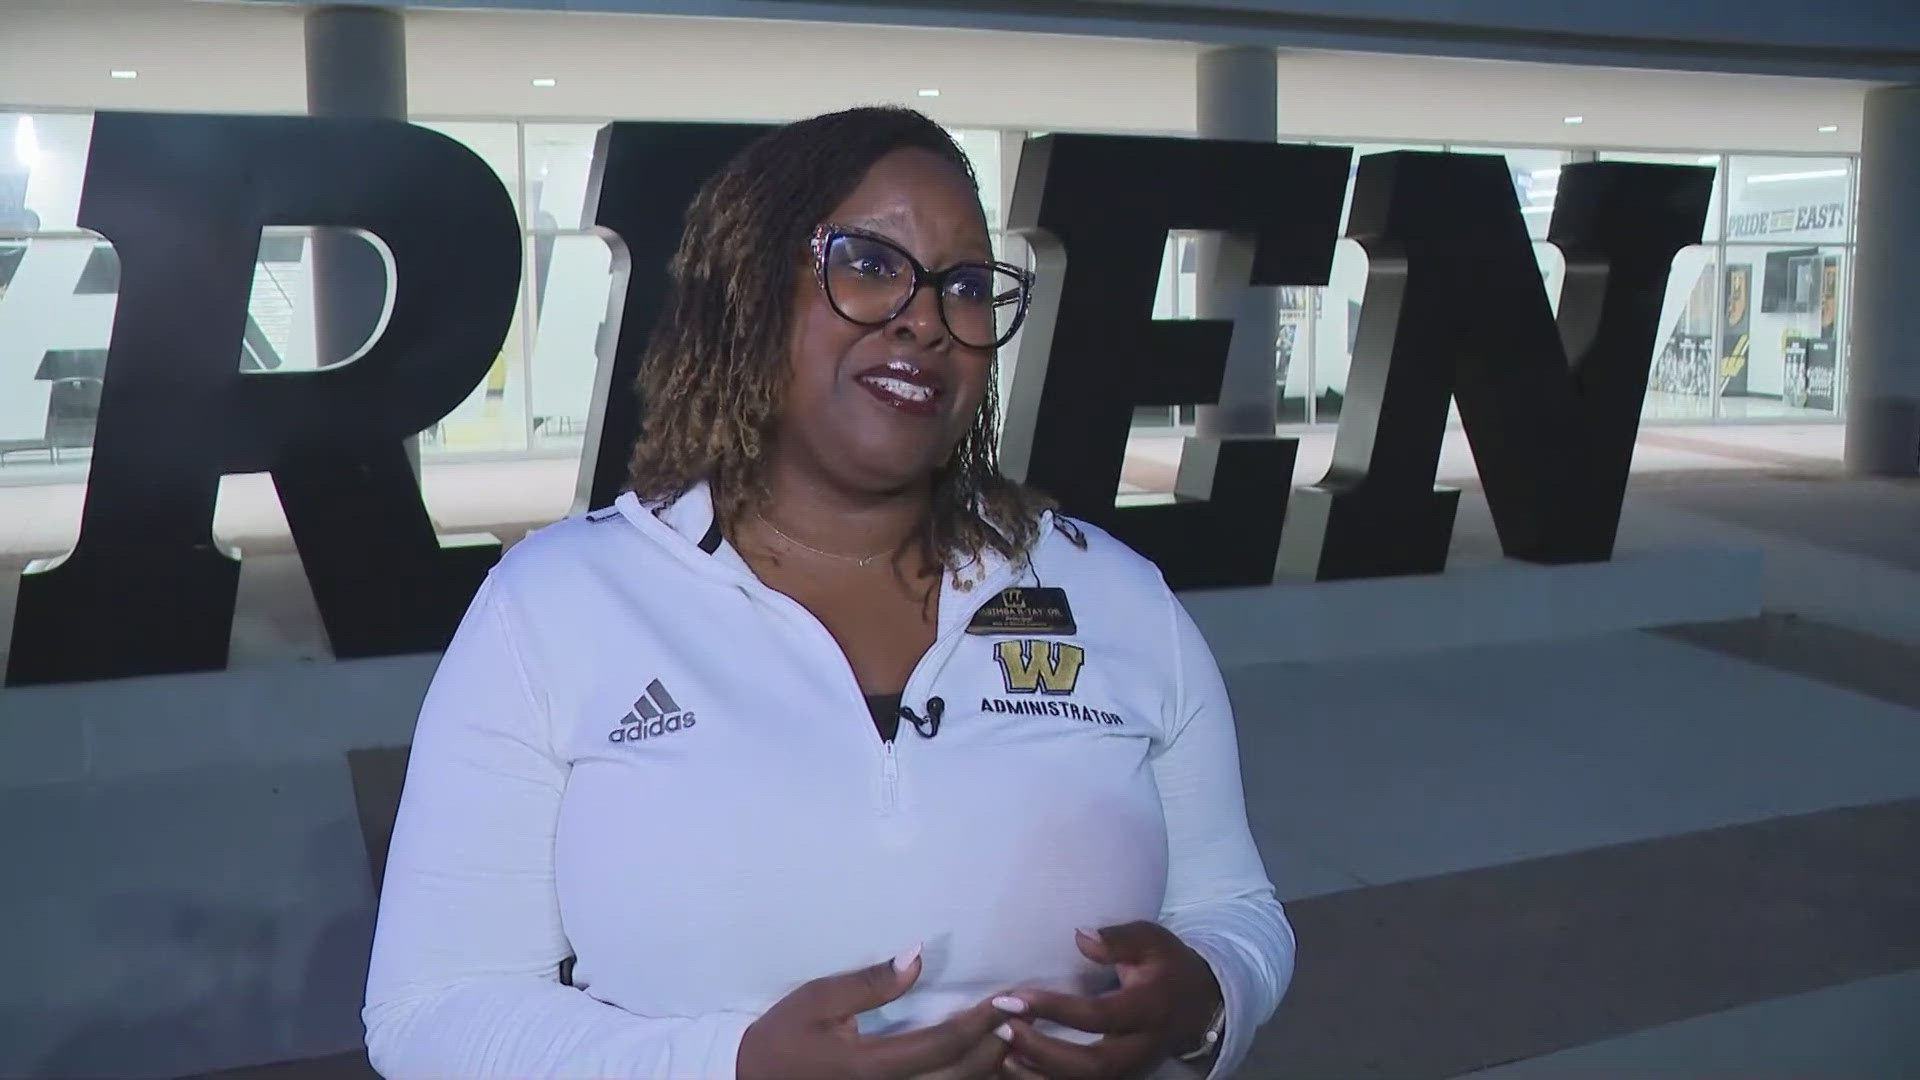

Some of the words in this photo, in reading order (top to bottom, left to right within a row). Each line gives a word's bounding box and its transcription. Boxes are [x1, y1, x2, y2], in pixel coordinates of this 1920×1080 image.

[1728, 212, 1769, 237] PRIDE
[993, 639, 1084, 696] W
[608, 711, 696, 743] adidas
[981, 698, 1124, 726] ADMINISTRATOR
